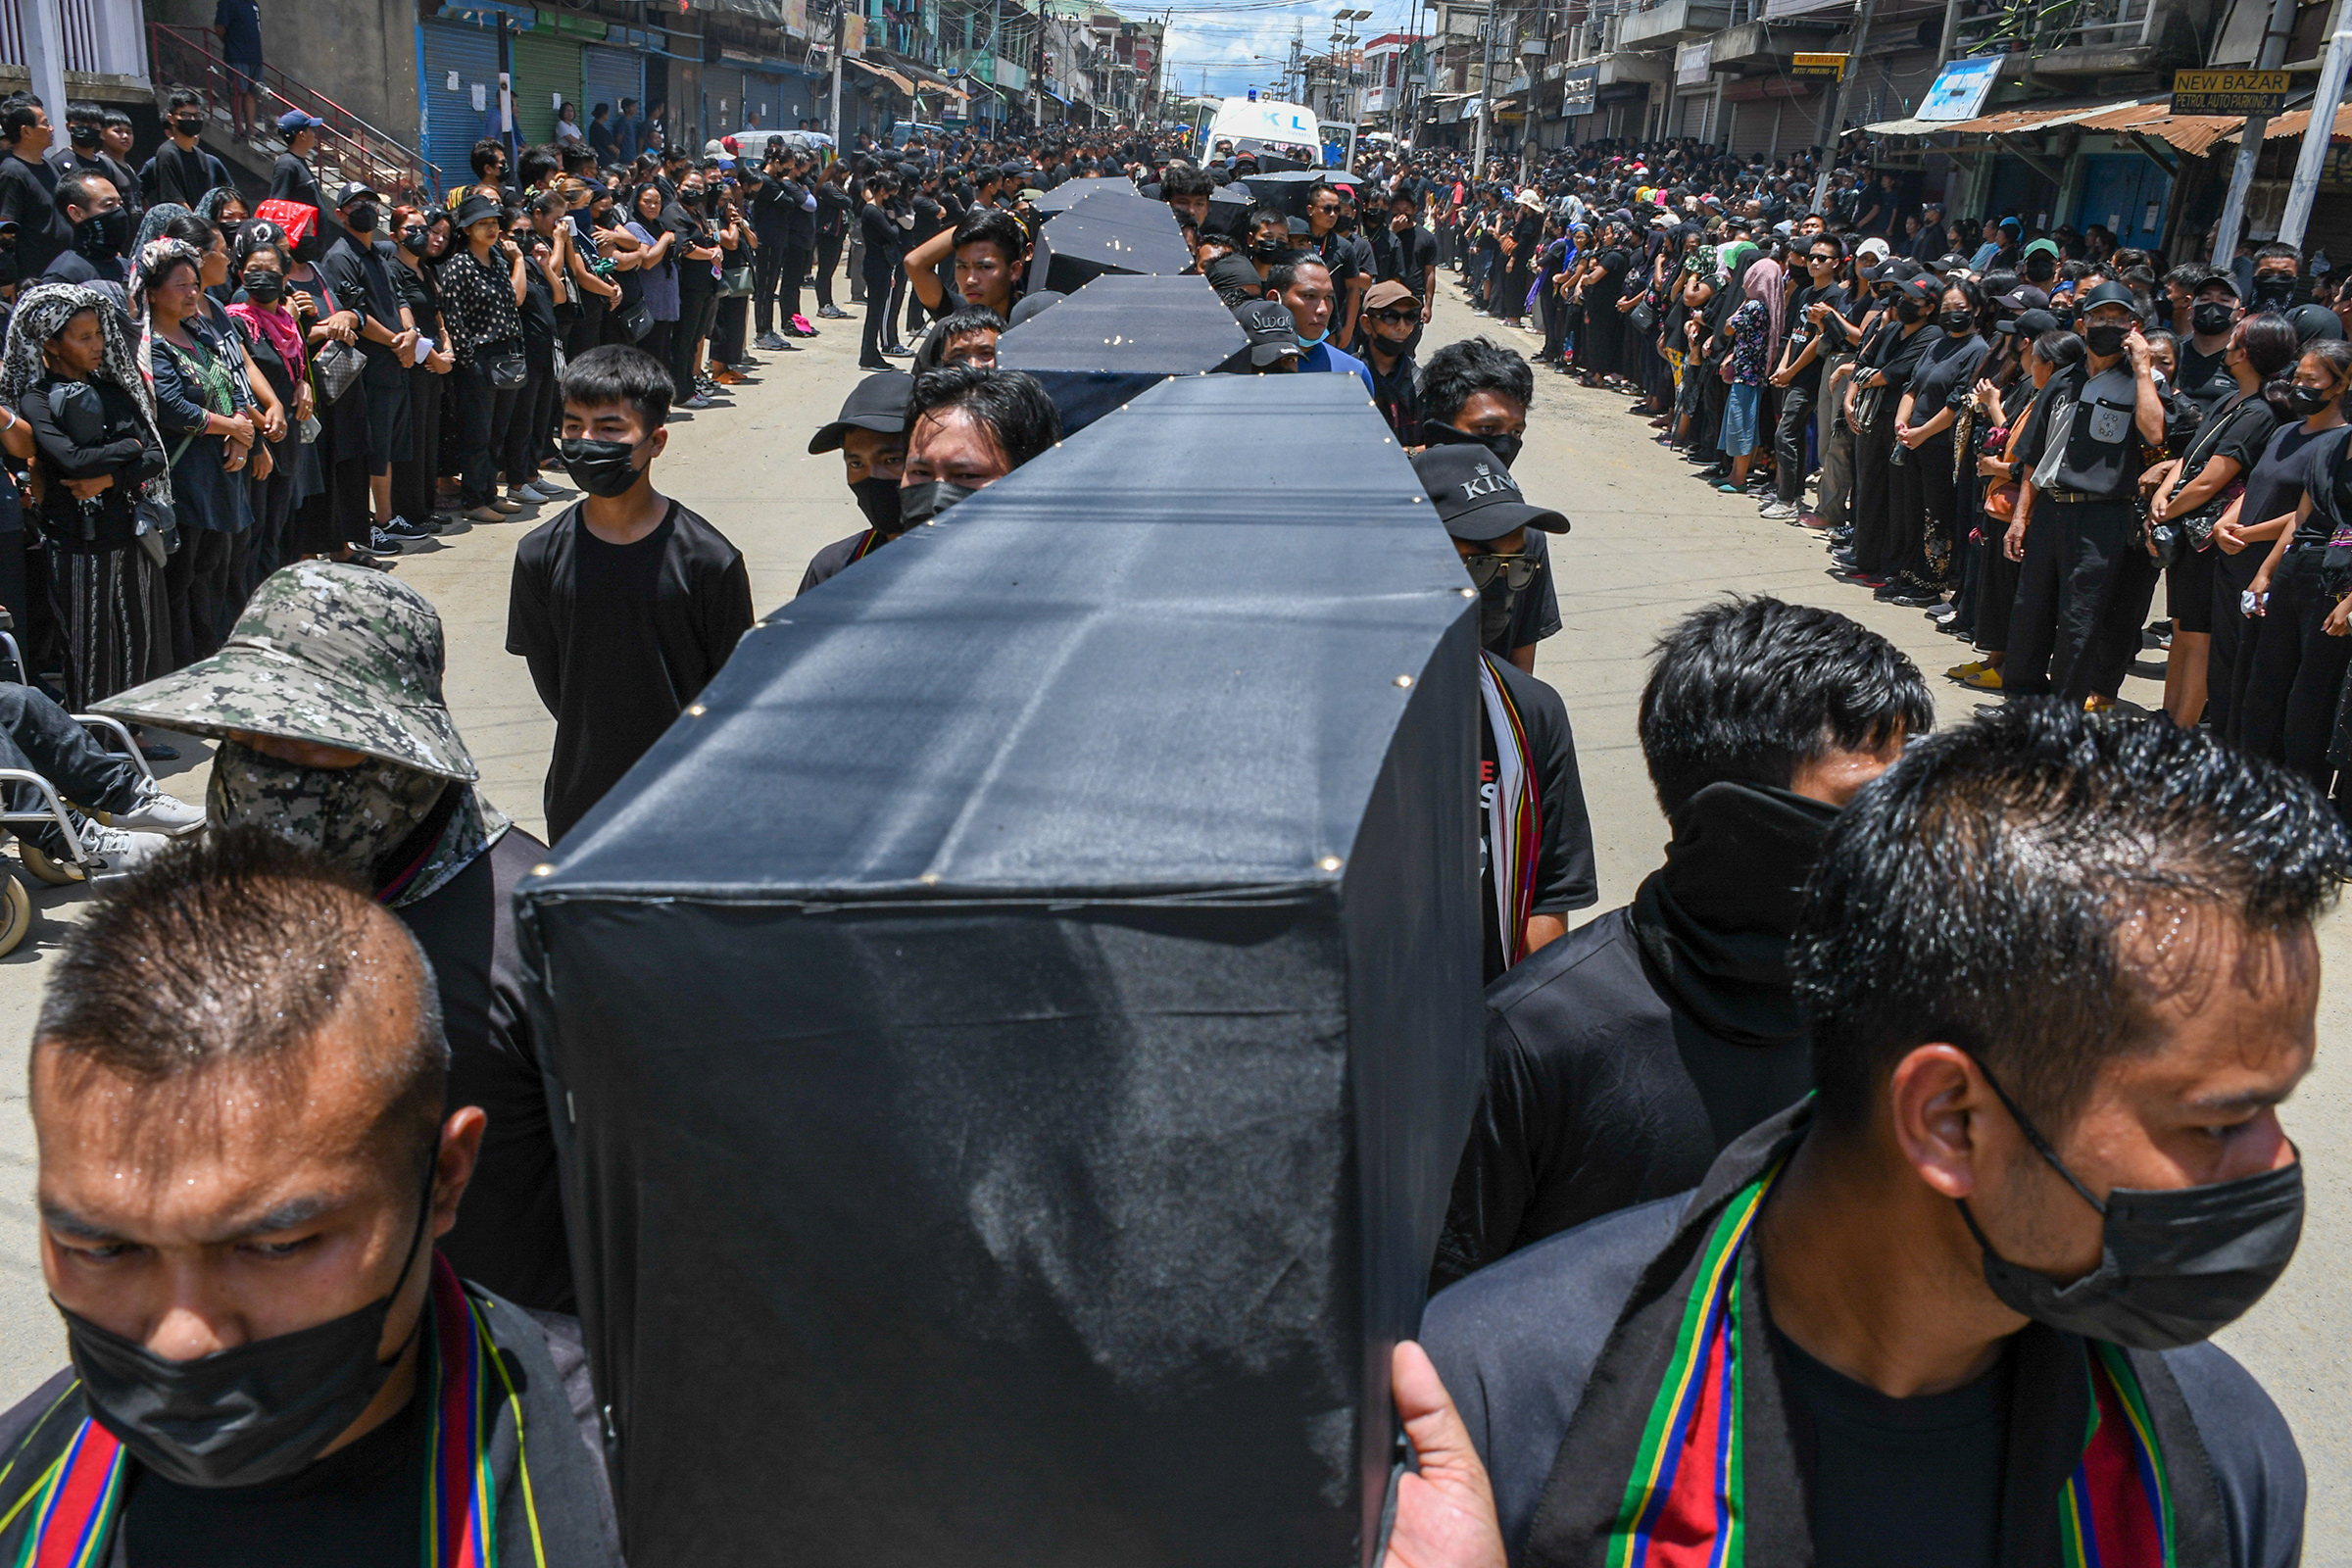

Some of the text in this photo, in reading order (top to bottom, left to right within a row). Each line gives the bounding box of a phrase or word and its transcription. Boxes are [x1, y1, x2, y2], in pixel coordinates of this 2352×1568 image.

[2177, 74, 2284, 90] NEW BAZAR
[2176, 94, 2206, 108] PETROL
[2207, 94, 2231, 109] AUTO
[2230, 95, 2268, 108] PARKING
[1292, 116, 1306, 131] L
[1252, 311, 1293, 332] Swag
[1459, 474, 1520, 501] KIN
